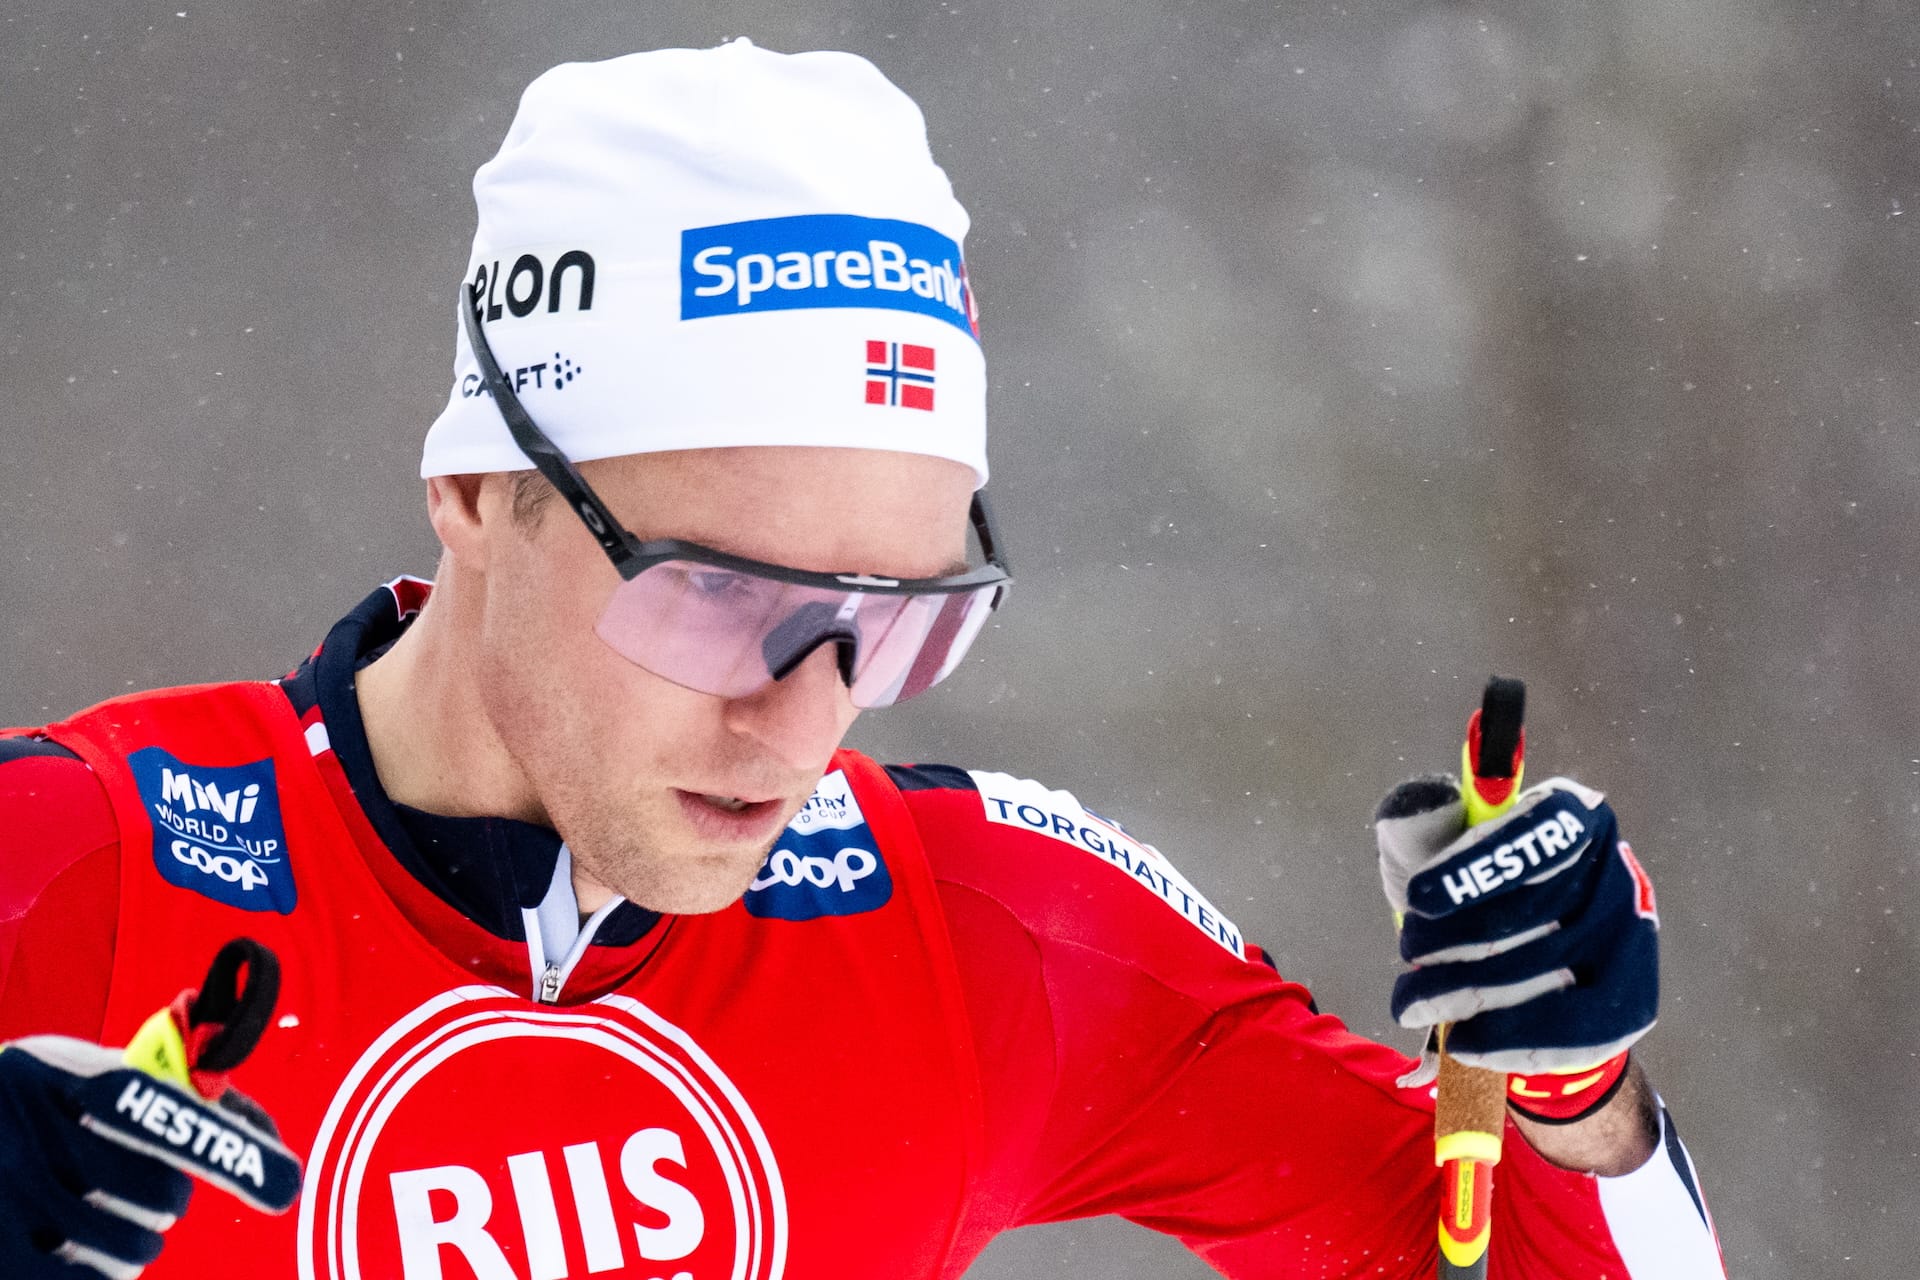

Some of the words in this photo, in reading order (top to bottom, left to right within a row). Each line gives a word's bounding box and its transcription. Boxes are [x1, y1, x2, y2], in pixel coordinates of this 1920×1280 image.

[693, 240, 966, 315] SpareBank
[155, 803, 229, 843] WORLD
[1441, 810, 1586, 906] HESTRA
[988, 797, 1239, 954] TORGHATTEN
[115, 1078, 265, 1188] HESTRA
[388, 1127, 706, 1280] RIIS
